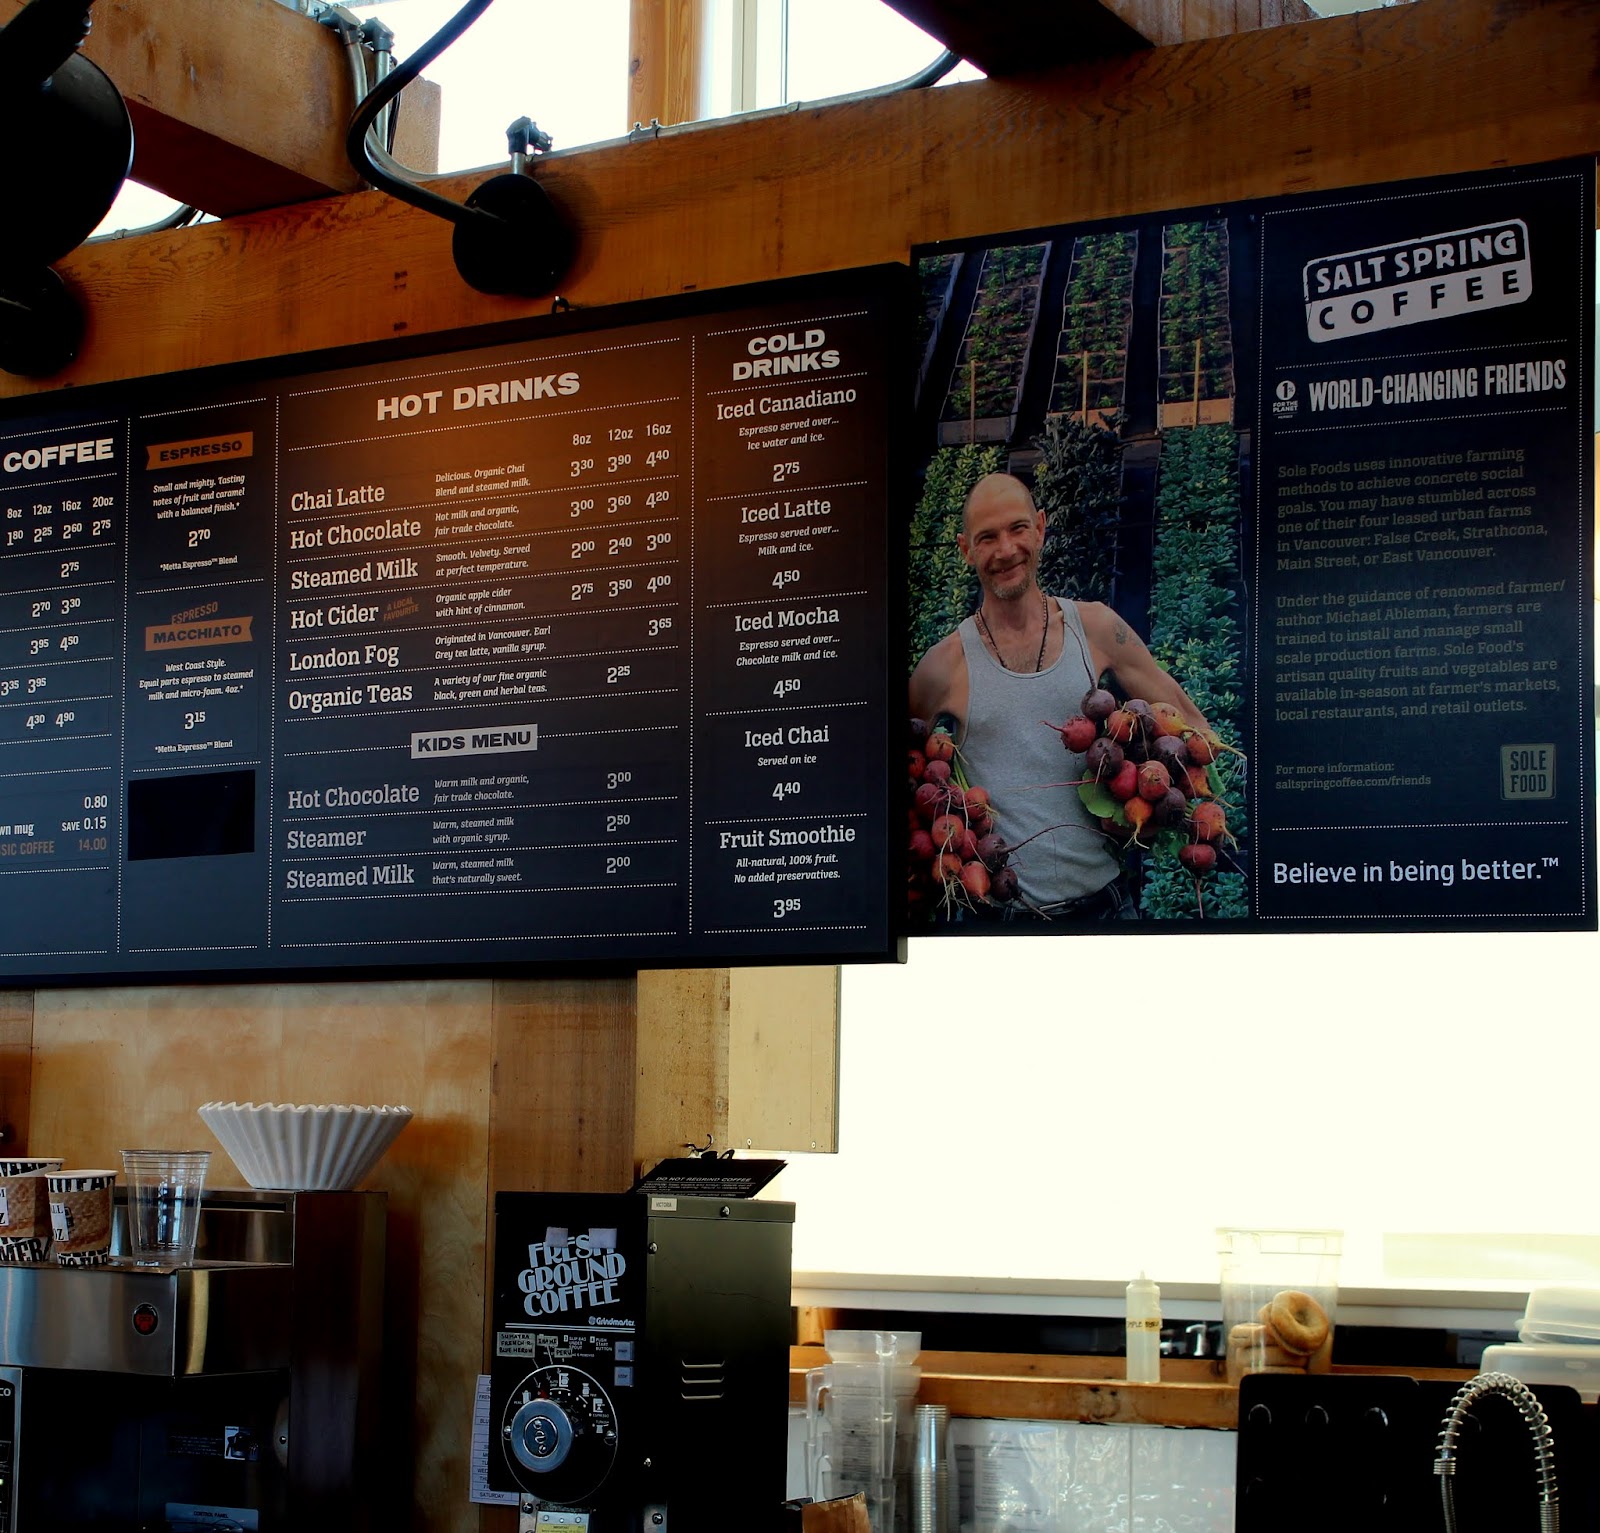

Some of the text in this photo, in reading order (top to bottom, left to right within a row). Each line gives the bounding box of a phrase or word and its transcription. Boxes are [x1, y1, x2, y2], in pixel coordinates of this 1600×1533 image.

[1316, 230, 1517, 293] SALT SPRING
[1319, 269, 1520, 330] COFFEE
[748, 329, 825, 356] COLD
[733, 350, 840, 381] DRINKS
[377, 372, 580, 421] HOT DRINKS
[1309, 360, 1566, 412] WORLD-CHANGING FRIENDS
[717, 388, 856, 420] Iced Canadiano
[572, 424, 672, 446] 8oz 12oz 16oz
[738, 416, 839, 437] Espresso served over...
[159, 440, 242, 462] ESPRESSO
[747, 432, 824, 450] Ice water and ice.
[3, 438, 114, 473] COFFEE
[1278, 449, 1524, 478] Sole Foods uses innovative farming
[152, 474, 245, 493] Small and mighty. Tasting
[435, 463, 525, 482] Delicious. Organic Chai
[1278, 465, 1524, 496] methods to achieve concrete social
[152, 486, 245, 506] notes of fruit and caramel
[435, 477, 530, 496] Blend and steamed milk.
[7, 496, 114, 518] 8oz 12oz 16oz 20oz
[291, 486, 385, 512] Chai Latte
[157, 509, 173, 519] with
[180, 504, 212, 516] balanced
[435, 504, 519, 521] Hot milk and organic,
[742, 500, 832, 523] Iced Latte
[290, 519, 422, 549] Hot Chocolate
[434, 519, 514, 538] fair trade chocolate.
[291, 558, 418, 590] Steamed Milk
[435, 587, 512, 604] Organic apple cider
[1276, 579, 1566, 608] Under the guidance of renowned farmer/
[171, 601, 219, 625] ESPRESSO
[290, 604, 378, 630] Hot Cider
[735, 607, 840, 632] Iced Mocha
[153, 624, 242, 644] MACCHIATO
[435, 625, 550, 646] Originated in Vancouver. Earl
[165, 658, 226, 672] West Coast Style.
[290, 645, 399, 671] London Fog
[289, 684, 412, 714] Organic Teas
[418, 731, 531, 752] KIDS MENU
[745, 725, 830, 747] Iced Chai
[1275, 762, 1394, 774] For more information:
[1510, 750, 1546, 772] SOLE
[1276, 775, 1432, 790] saltspringcoffee.com/friends
[1510, 774, 1547, 792] FOOD
[84, 796, 108, 809] 0.80
[288, 784, 420, 809] Hot Chocolate
[14, 816, 107, 836] mug SAVE 0.15
[720, 825, 856, 848] Fruit Smoothie
[20, 838, 107, 854] COFFEE 14.00
[287, 830, 366, 850] Steamer
[736, 853, 838, 867] All-natural, 100% fruit.
[286, 864, 414, 889] Steamed Milk
[734, 869, 840, 883] No added preservatives.
[1274, 862, 1356, 884] Believe
[1364, 862, 1383, 882] in
[1390, 860, 1454, 886] being
[518, 1253, 626, 1294] GROUND
[524, 1278, 620, 1316] COFFEE
